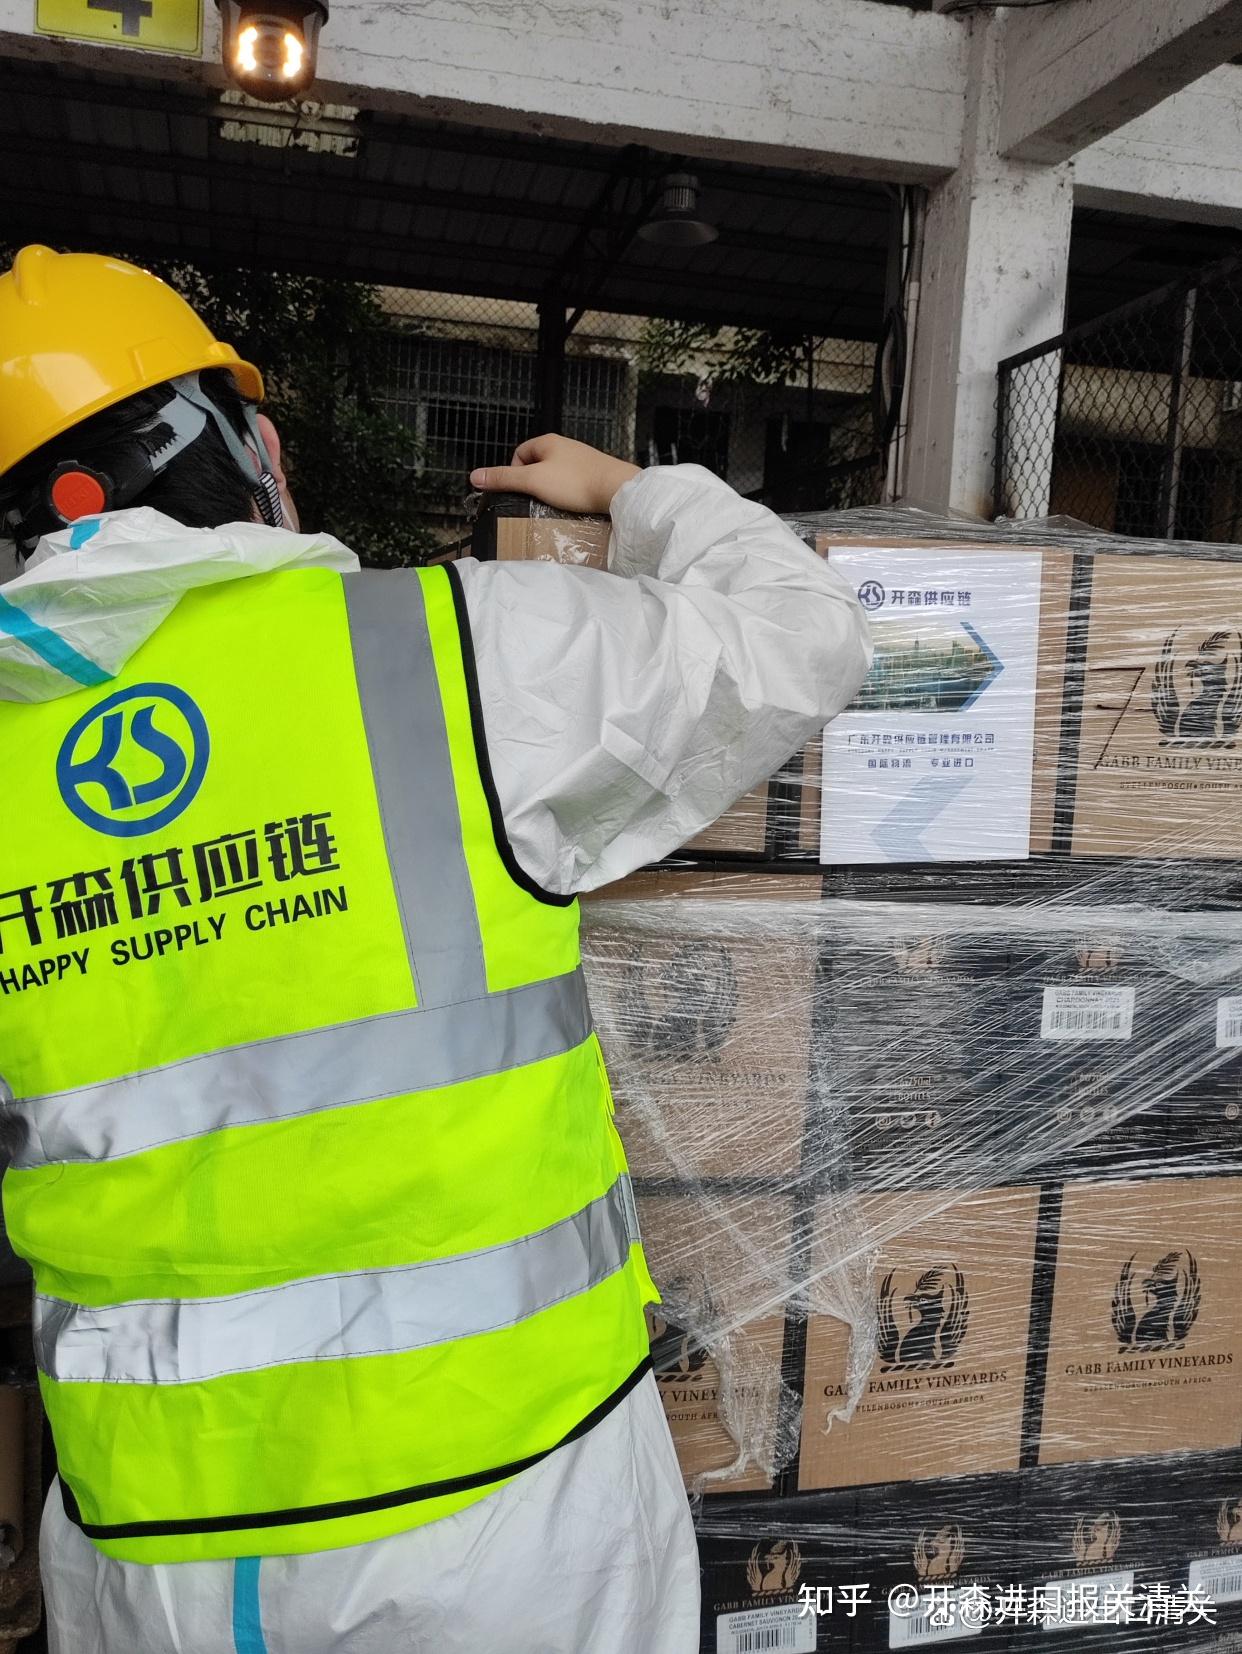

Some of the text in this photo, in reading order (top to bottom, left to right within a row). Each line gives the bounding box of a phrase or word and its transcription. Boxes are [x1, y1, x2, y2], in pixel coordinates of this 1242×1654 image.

[891, 590, 971, 606] 开森供应链
[931, 757, 974, 768] 专业进口
[1146, 756, 1202, 769] FAMILY
[0, 885, 348, 995] HAPPY SUPPLY CHAIN
[1065, 1353, 1233, 1375] GABB FAMILY VINEYARDS
[869, 1377, 923, 1393] FAMILY
[926, 1370, 1007, 1389] VINEYARDS
[713, 1600, 739, 1612] GABB
[742, 1597, 775, 1609] FAMILY
[728, 1620, 758, 1630] CABERNET
[760, 1615, 791, 1626] SAUVIGNON
[747, 1612, 768, 1620] FAMILY
